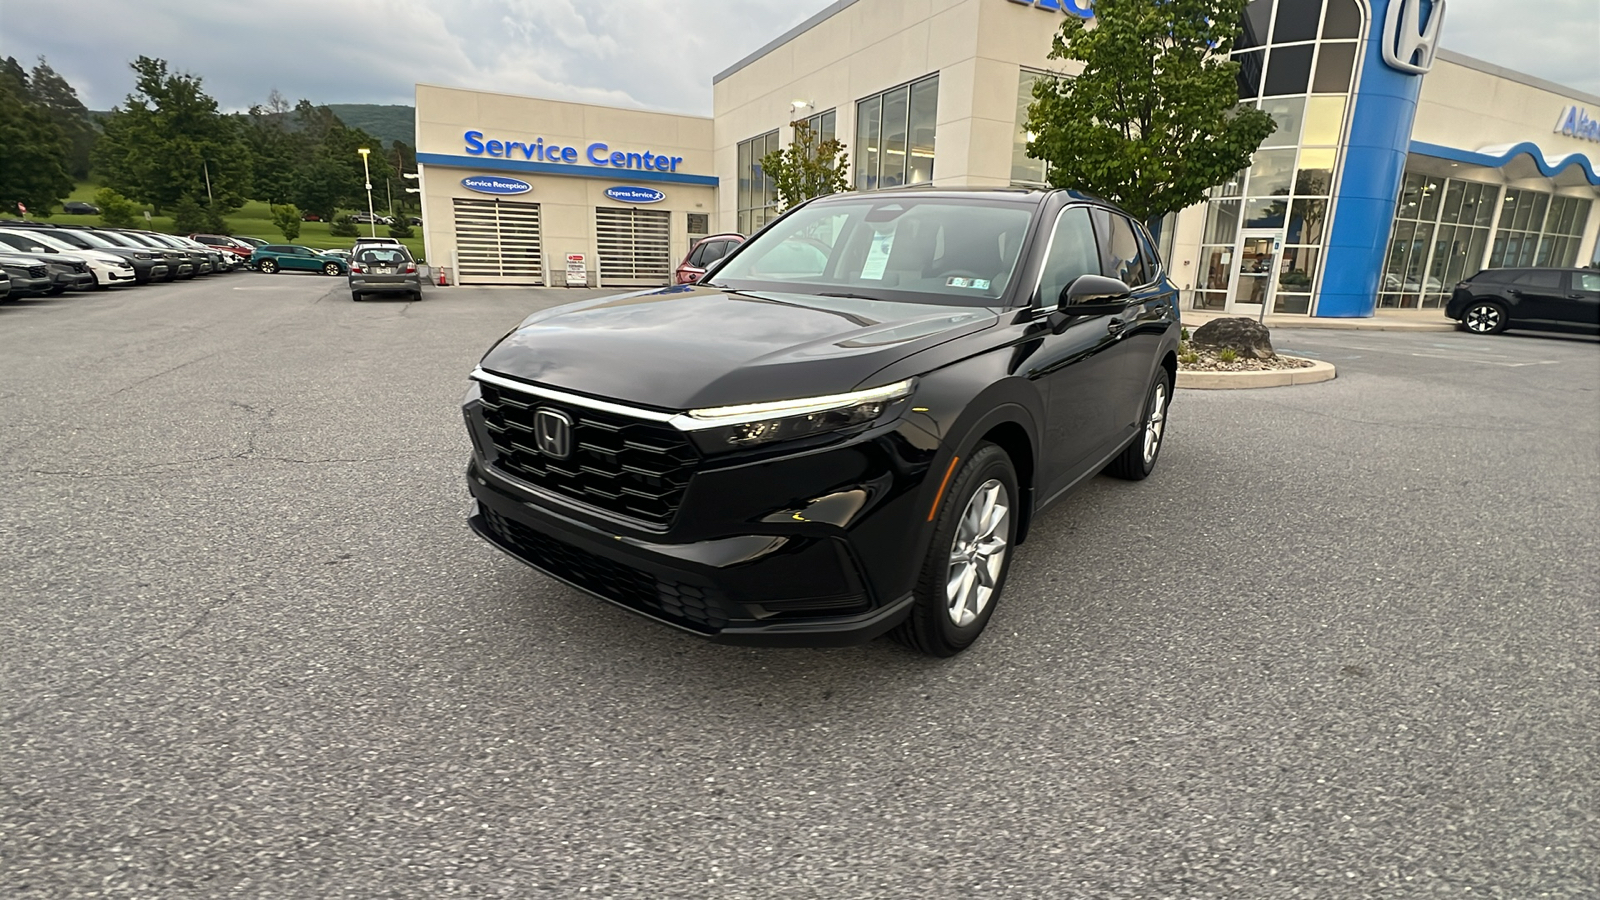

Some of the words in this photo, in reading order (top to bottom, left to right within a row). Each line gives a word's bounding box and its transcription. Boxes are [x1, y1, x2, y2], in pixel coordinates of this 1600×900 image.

[464, 130, 578, 163] Service
[586, 143, 683, 172] Center
[465, 179, 492, 187] Service
[493, 181, 528, 190] Reception
